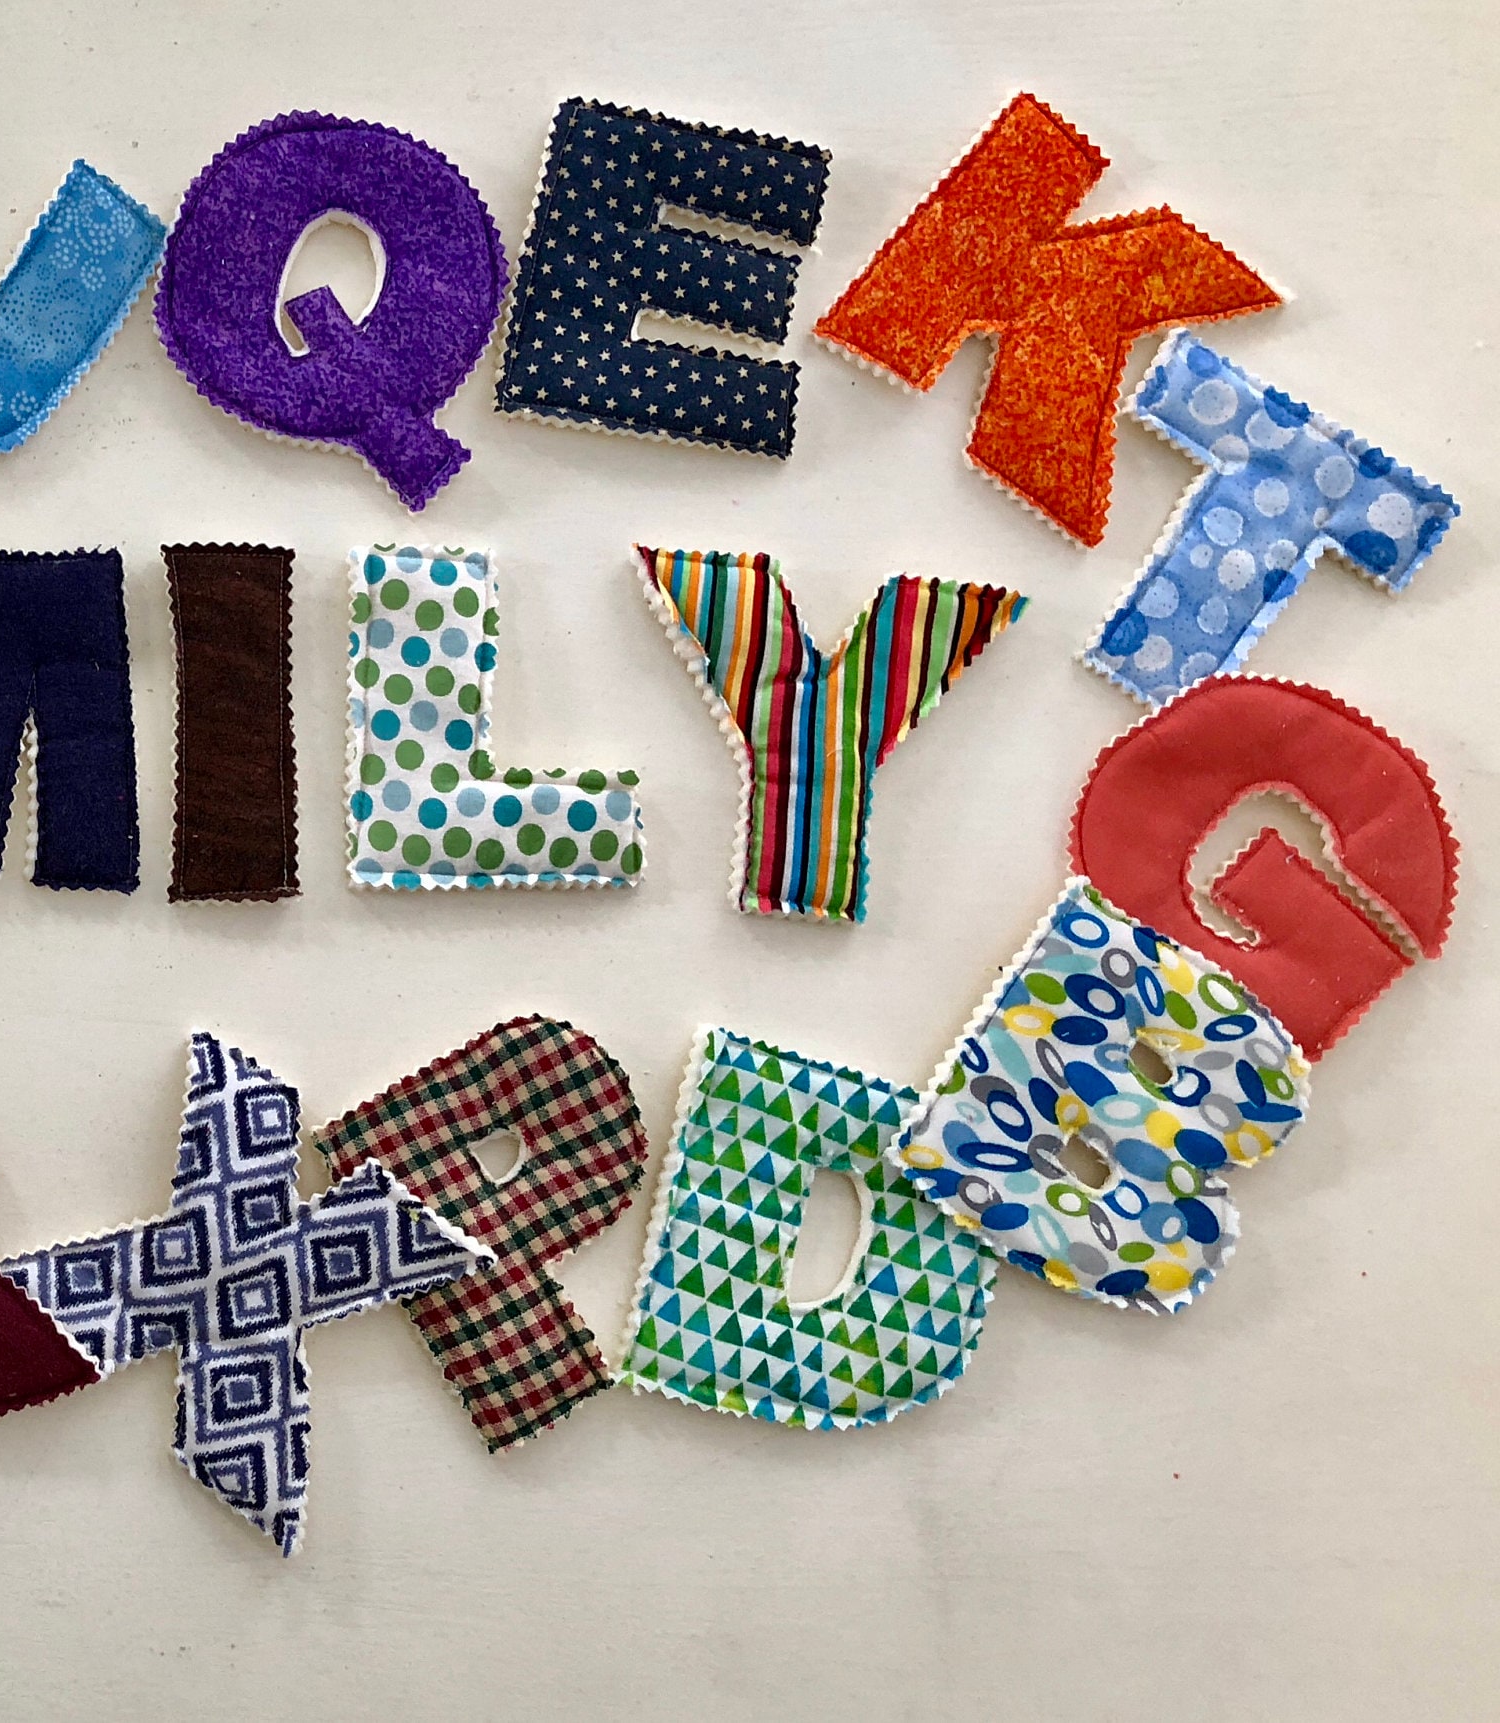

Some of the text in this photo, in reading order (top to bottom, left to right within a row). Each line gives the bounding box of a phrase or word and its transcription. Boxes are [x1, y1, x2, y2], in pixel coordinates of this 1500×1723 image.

[152, 109, 508, 514] Q
[493, 96, 834, 460] E
[813, 91, 1295, 550] K
[1077, 328, 1462, 709] T
[1066, 670, 1462, 1064] G
[312, 1011, 649, 1456] P
[612, 1022, 998, 1432] D
[891, 875, 1312, 1317] B
